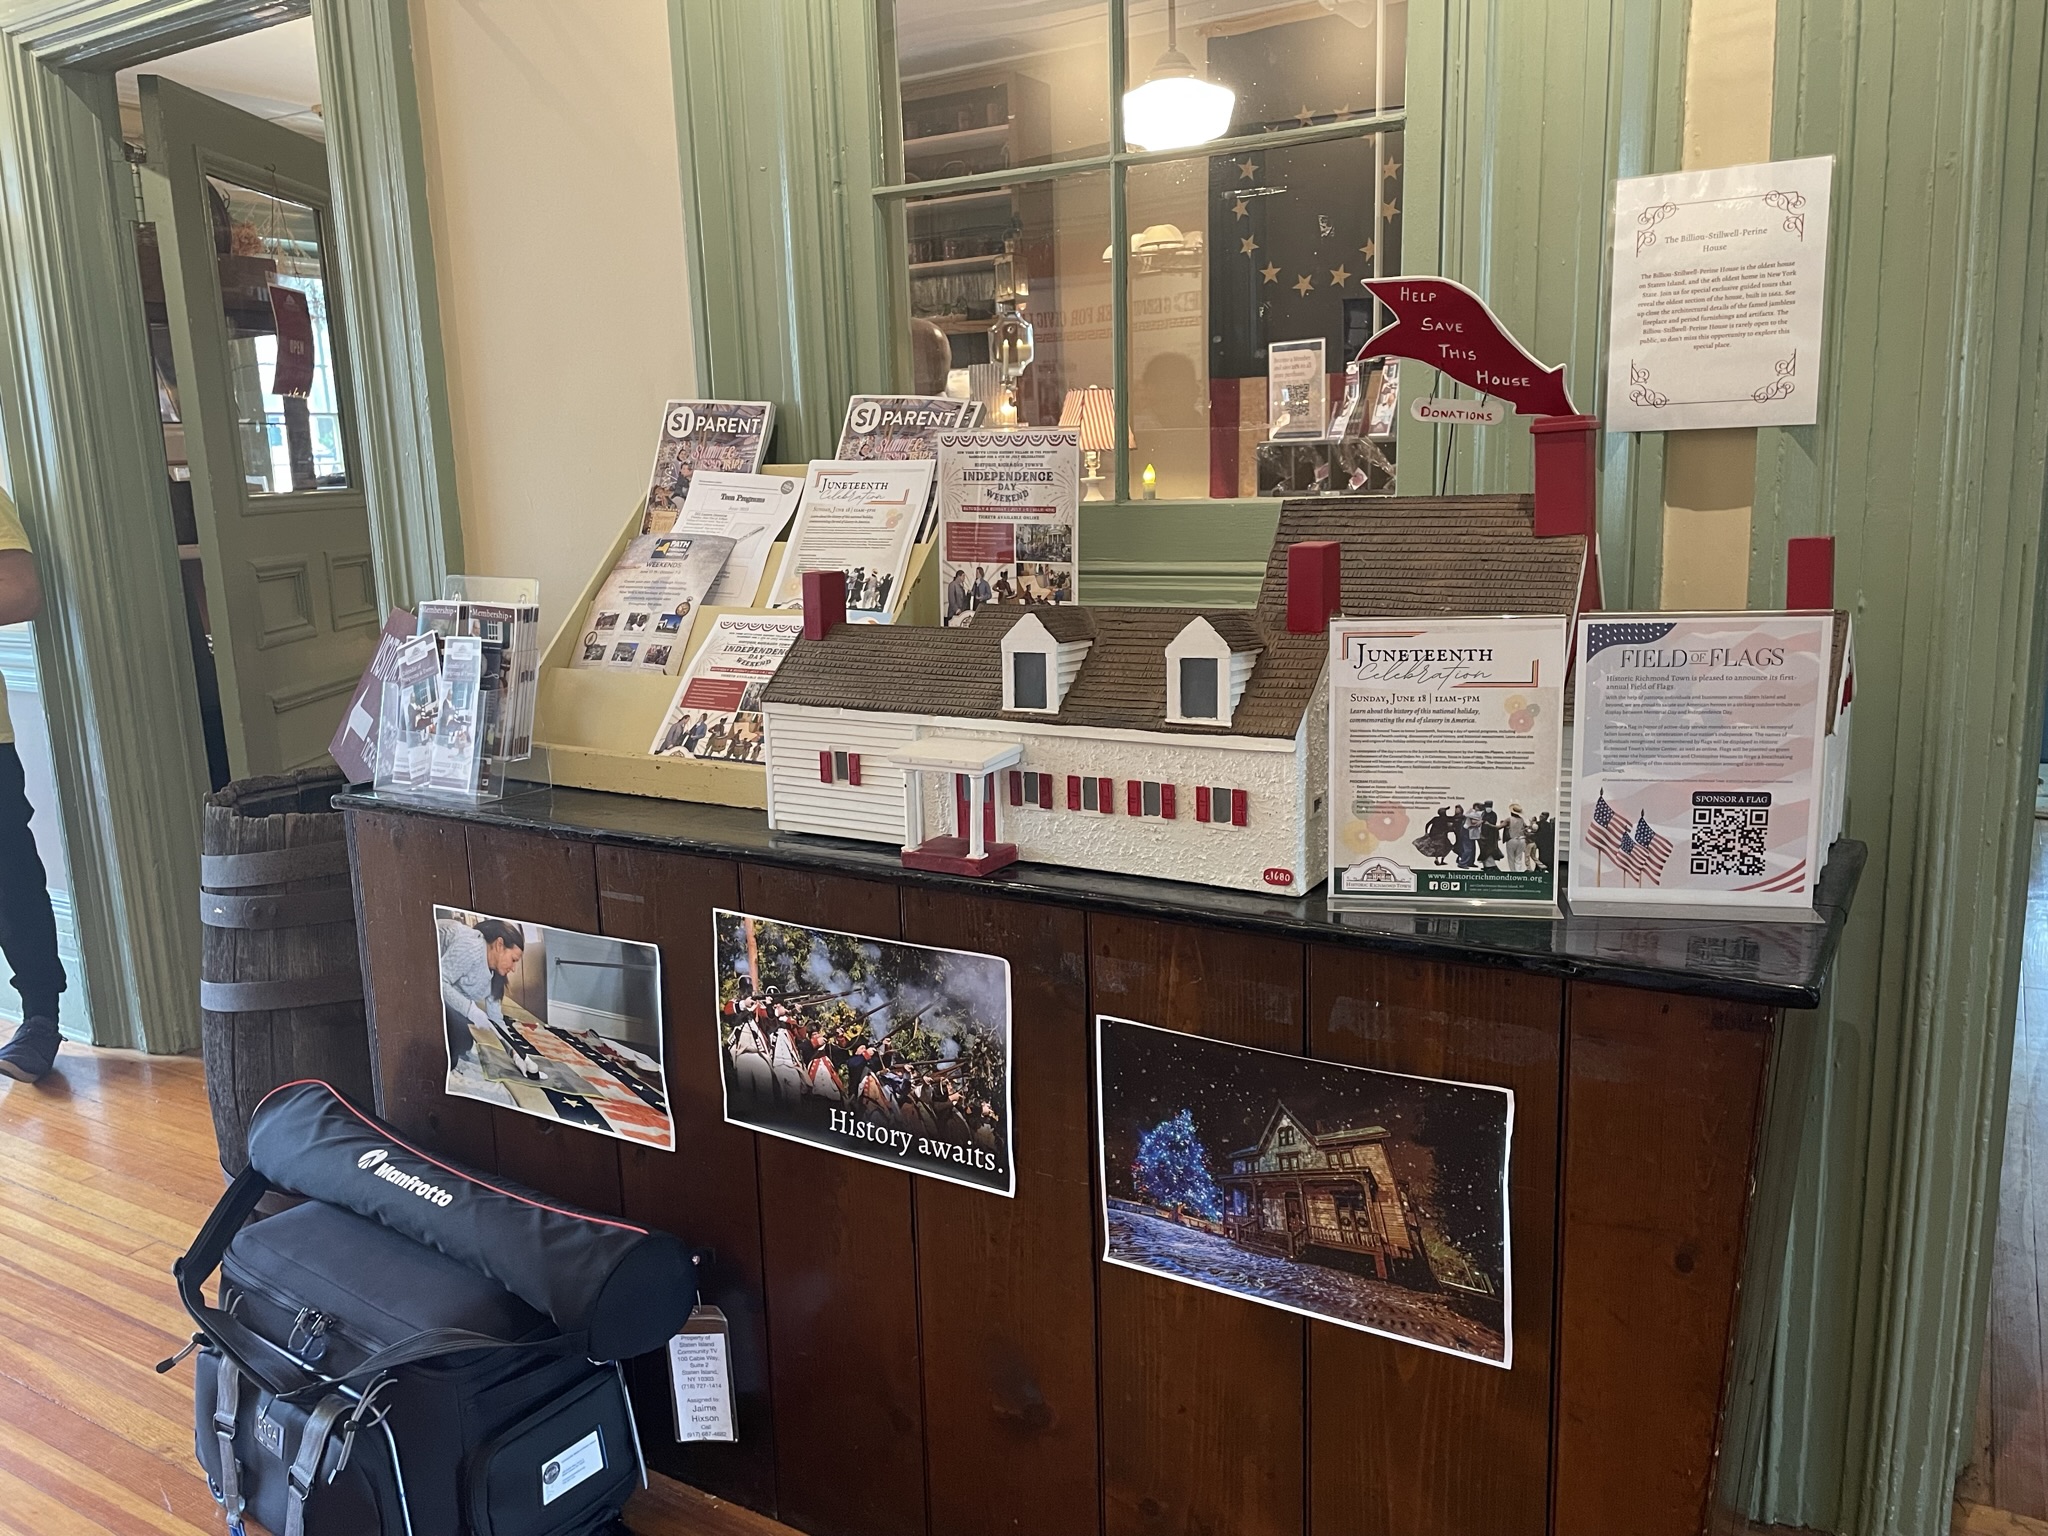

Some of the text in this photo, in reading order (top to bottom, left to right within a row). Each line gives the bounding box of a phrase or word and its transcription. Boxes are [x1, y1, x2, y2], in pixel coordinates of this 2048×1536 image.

[1664, 236, 1680, 244] The
[1702, 244, 1728, 252] House
[1722, 274, 1740, 282] oldest
[1740, 282, 1760, 291] guided
[1400, 286, 1437, 303] HELP
[1420, 317, 1464, 333] SAVE
[1680, 316, 1700, 324] period
[1438, 343, 1477, 361] THIS
[1693, 342, 1713, 350] special
[1476, 370, 1531, 387] HOUSE
[855, 408, 956, 427] SI PARENT
[1420, 406, 1493, 422] DONATIONS
[671, 412, 761, 434] SI PARENT
[963, 471, 1054, 482] INDEPENDENCE
[819, 478, 889, 493] JUNETEENTH
[998, 482, 1017, 490] DAY
[986, 488, 1029, 502] WEEKEND
[670, 540, 690, 548] PATH
[472, 608, 508, 621] Membership
[736, 657, 772, 667] WEEKEND
[1353, 643, 1493, 669] JUNETEENTH
[1620, 648, 1785, 668] FIELD OF FLAGS
[1357, 654, 1492, 690] Celebration
[1698, 674, 1724, 682] pleased
[1350, 693, 1390, 705] SUNDAY,
[1390, 692, 1415, 705] JUNE
[1393, 708, 1414, 716] history
[1414, 708, 1420, 716] of
[1456, 708, 1480, 716] holiday,
[1349, 717, 1395, 725] commemorating
[1415, 717, 1423, 725] of
[1422, 717, 1443, 725] slavery
[1746, 796, 1768, 804] FLAG
[1264, 870, 1290, 882] c1680
[1427, 872, 1542, 883] www.historicrichmondtown.org
[829, 1108, 1004, 1174] History awaits.
[373, 1162, 453, 1207] Manfrotto
[692, 1404, 716, 1412] Jaime
